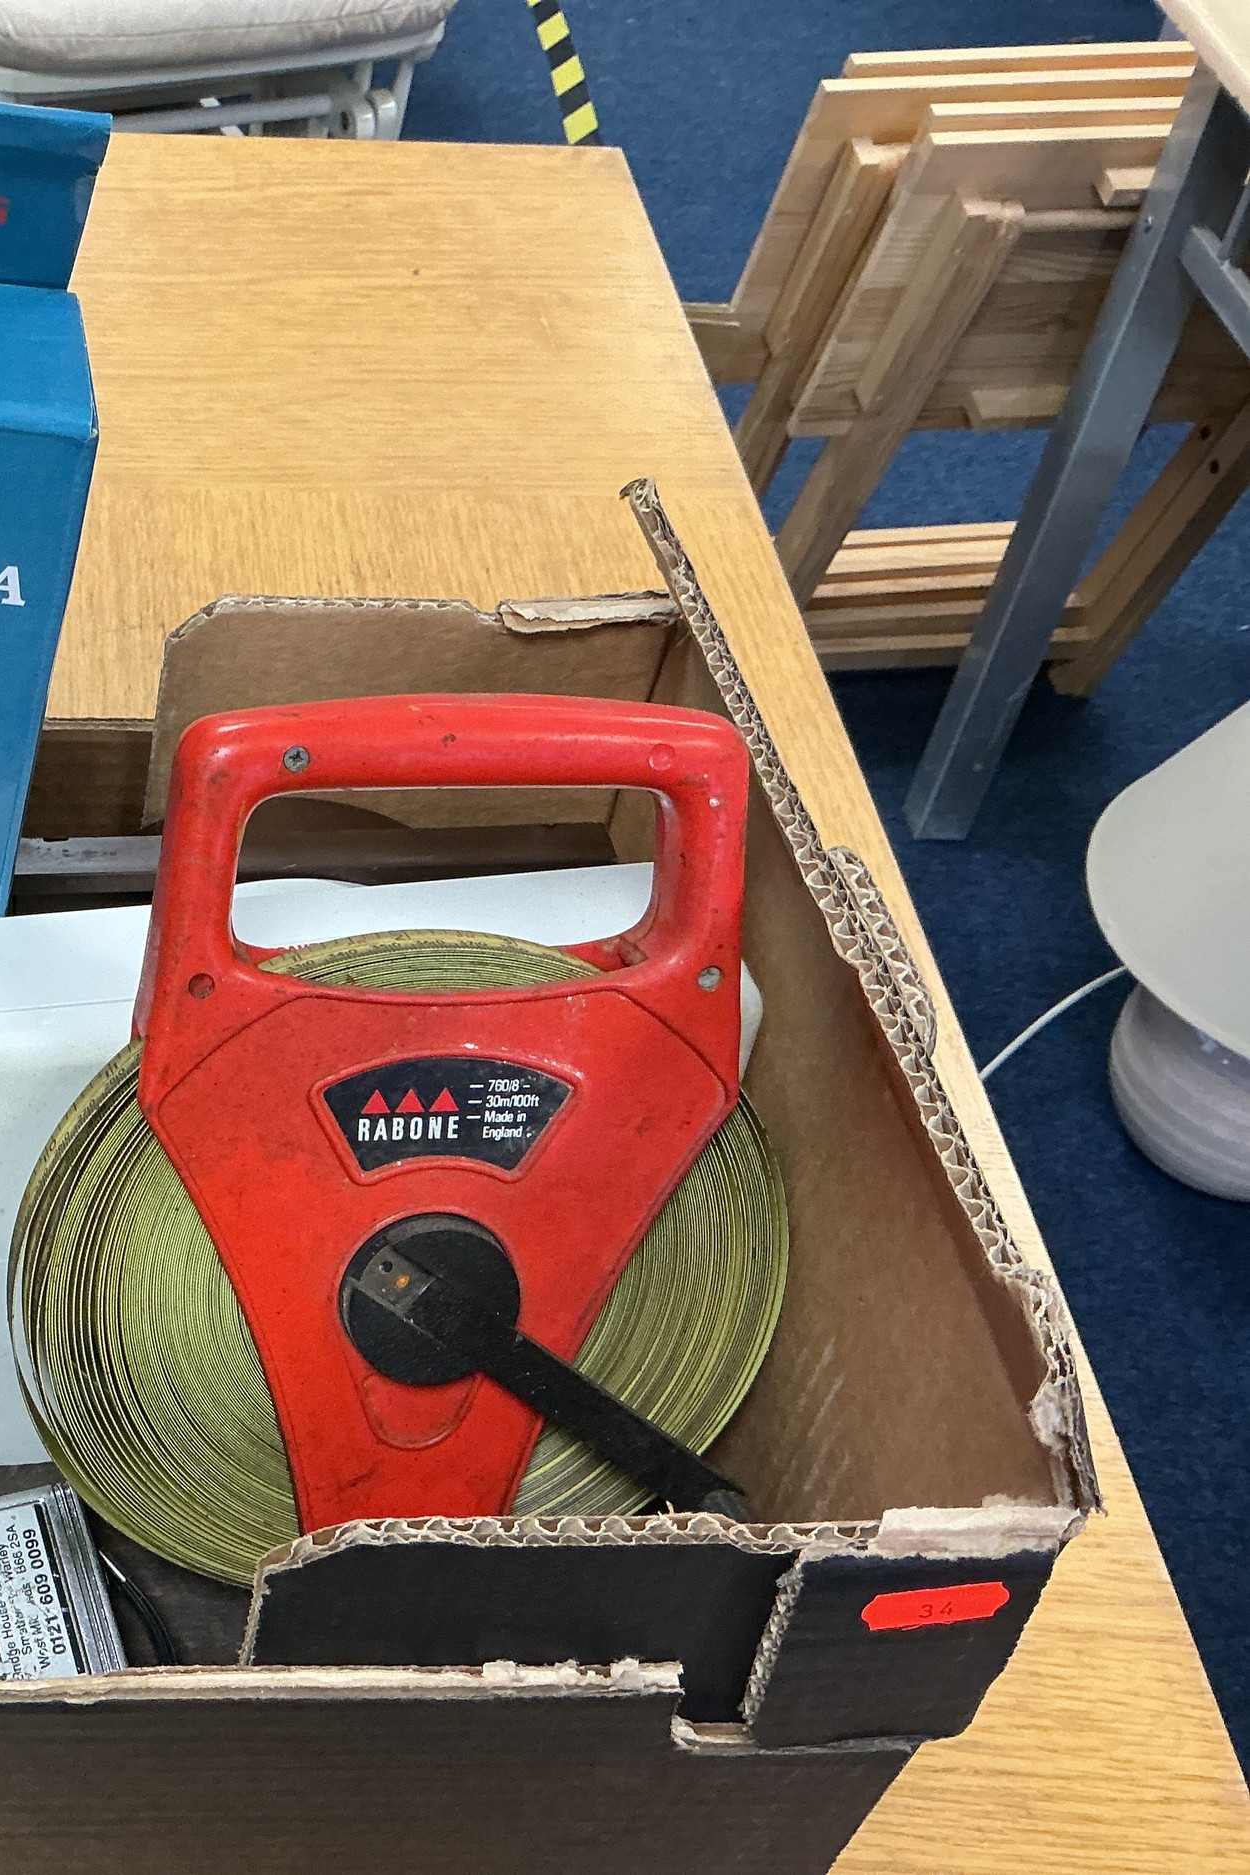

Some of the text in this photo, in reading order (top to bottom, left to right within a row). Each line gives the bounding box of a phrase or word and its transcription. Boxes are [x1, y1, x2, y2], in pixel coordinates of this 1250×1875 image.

[485, 1094, 540, 1108] 30m/100ft
[483, 1110, 527, 1123] Made in
[357, 1115, 461, 1142] RABONE
[482, 1126, 524, 1140] England
[7, 1524, 21, 1549] 2SA
[22, 1528, 45, 1570] 0099
[0, 1543, 14, 1584] Warley
[918, 1601, 955, 1619] 34
